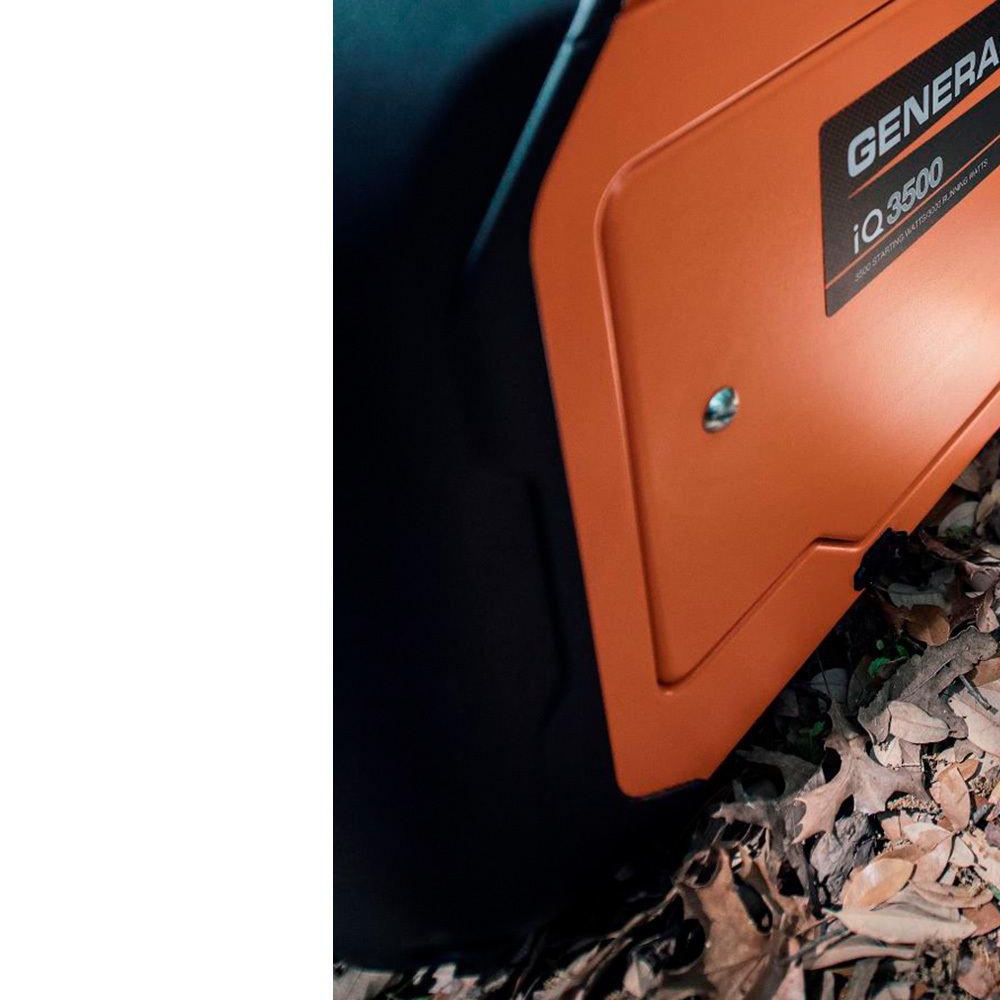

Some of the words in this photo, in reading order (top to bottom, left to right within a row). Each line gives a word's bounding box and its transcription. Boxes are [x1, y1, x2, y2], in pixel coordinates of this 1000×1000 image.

[853, 208, 884, 254] iQ
[886, 156, 943, 225] 3500
[872, 233, 904, 267] STARTING
